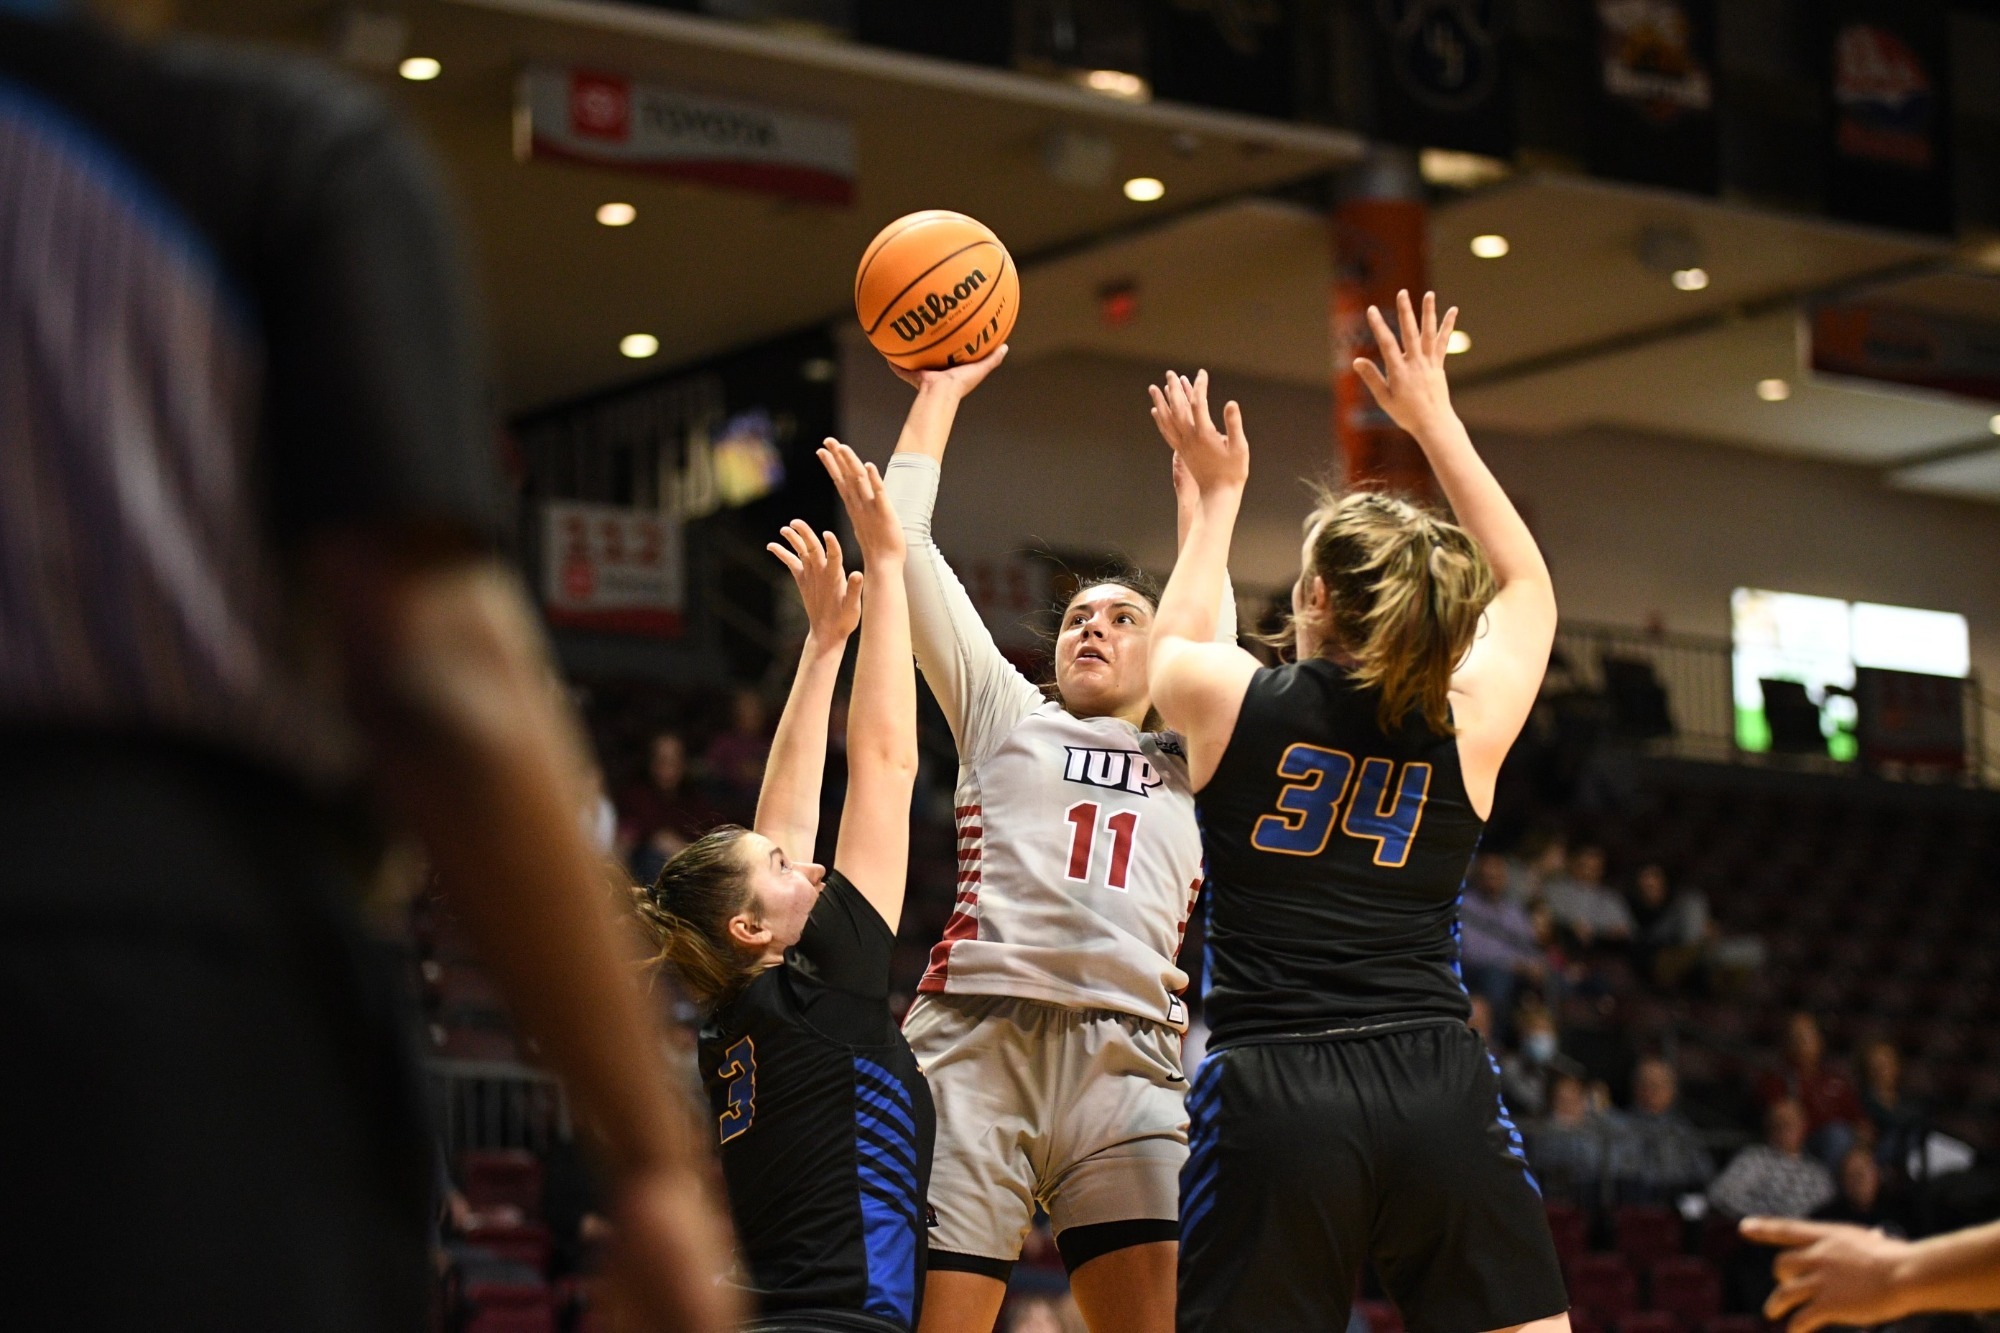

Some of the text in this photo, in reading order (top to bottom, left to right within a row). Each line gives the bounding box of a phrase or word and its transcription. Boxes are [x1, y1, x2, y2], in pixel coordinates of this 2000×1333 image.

[889, 269, 987, 342] Wilson
[1063, 745, 1163, 798] IUP
[1251, 742, 1432, 867] 34
[1063, 799, 1142, 894] 11
[718, 1034, 757, 1144] 3
